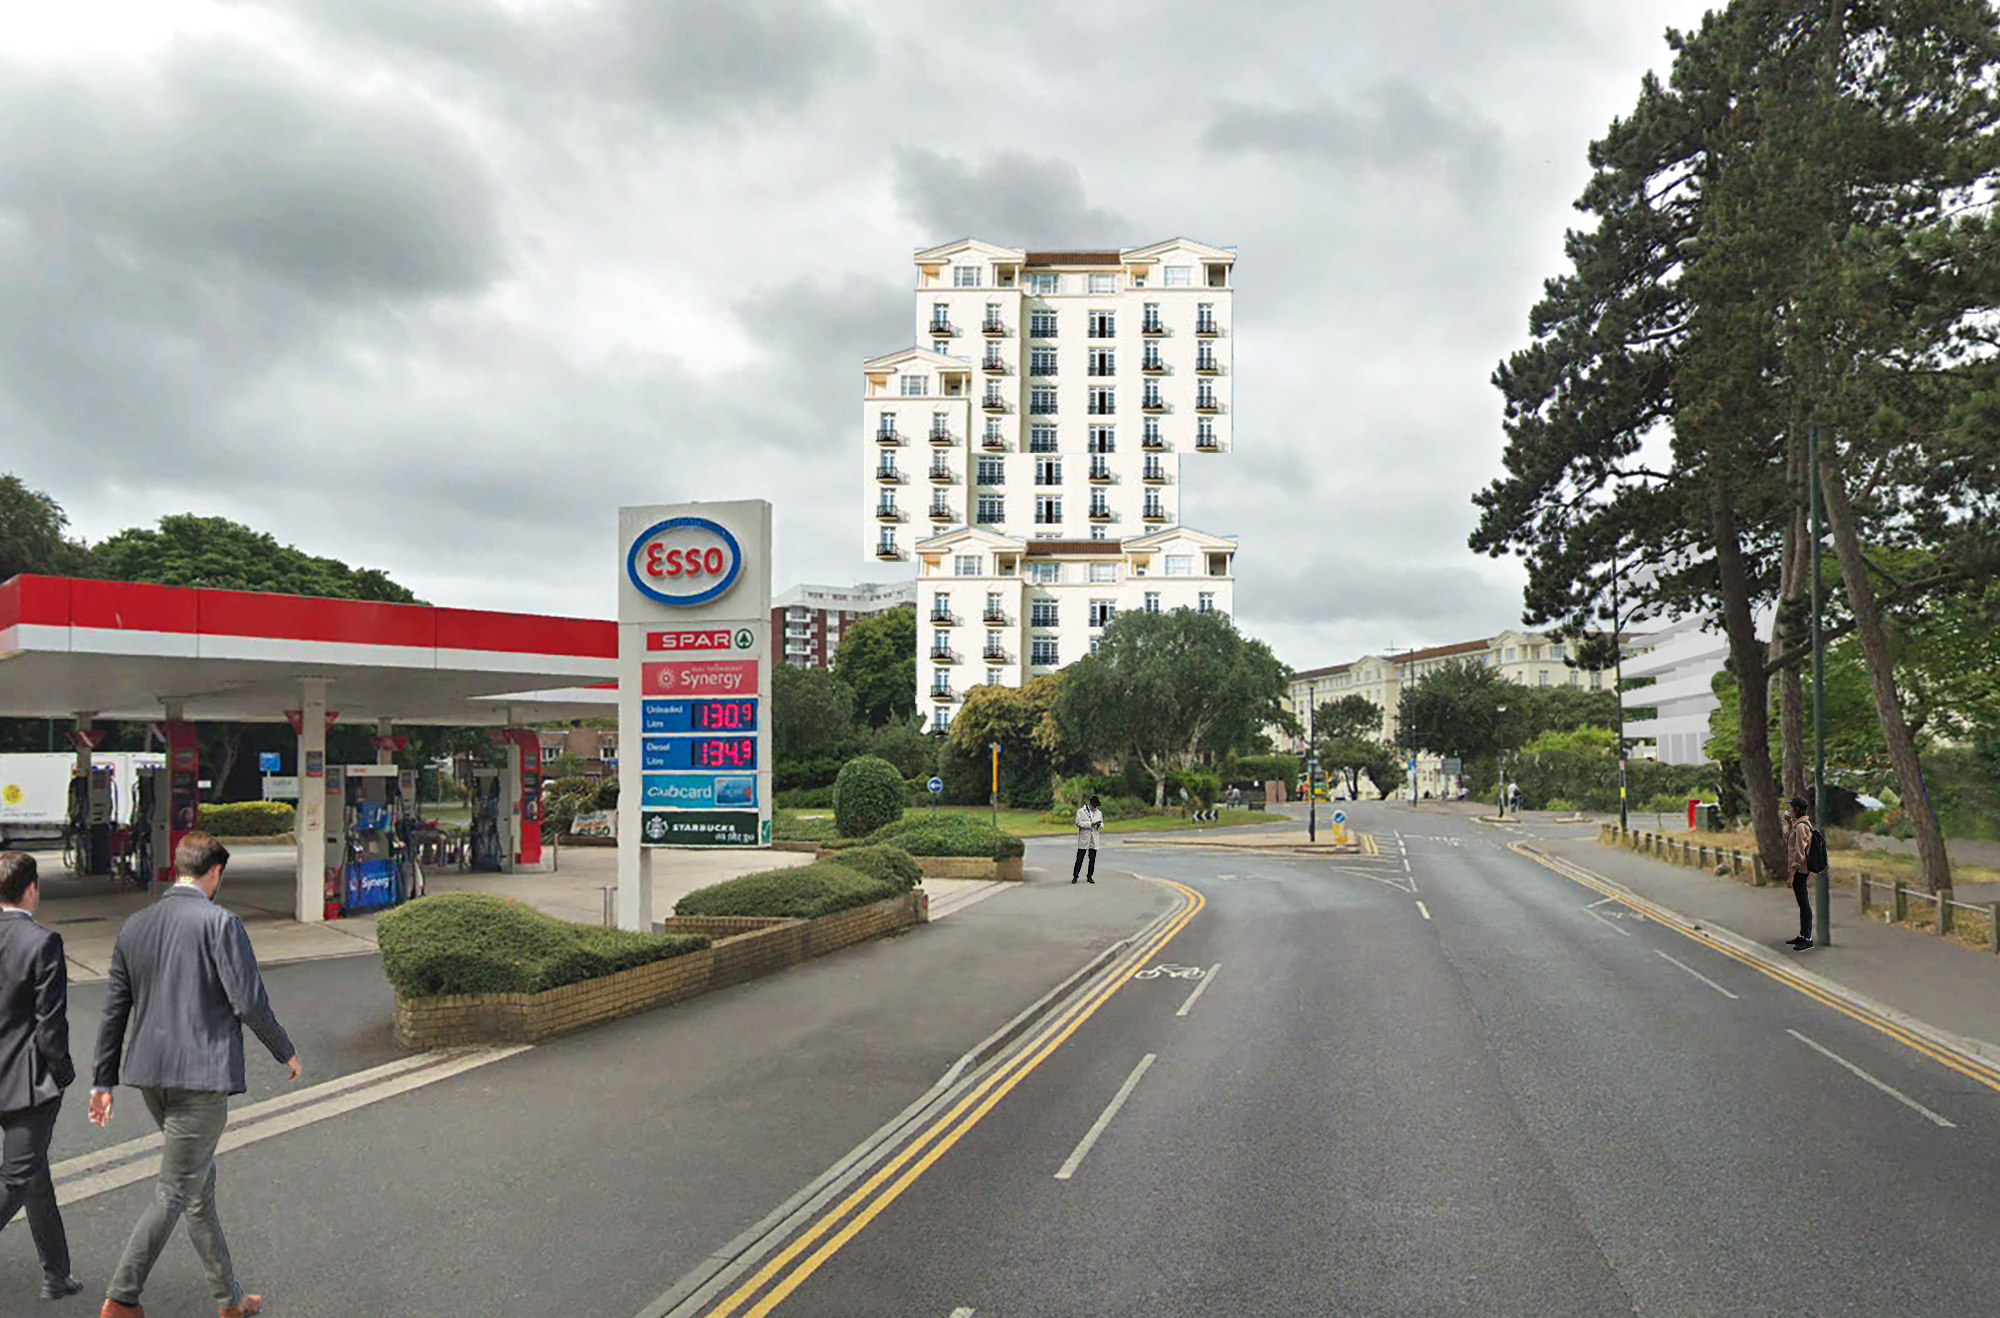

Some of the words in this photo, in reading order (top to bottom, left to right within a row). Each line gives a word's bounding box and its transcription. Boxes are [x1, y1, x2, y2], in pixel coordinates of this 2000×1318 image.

[646, 542, 723, 577] Esso
[662, 633, 729, 648] SPAR
[681, 670, 742, 689] Synergy
[646, 705, 683, 714] Unleaded
[646, 742, 670, 751] Diesel
[648, 785, 712, 798] Clubcard
[672, 823, 735, 832] STARBUCKS
